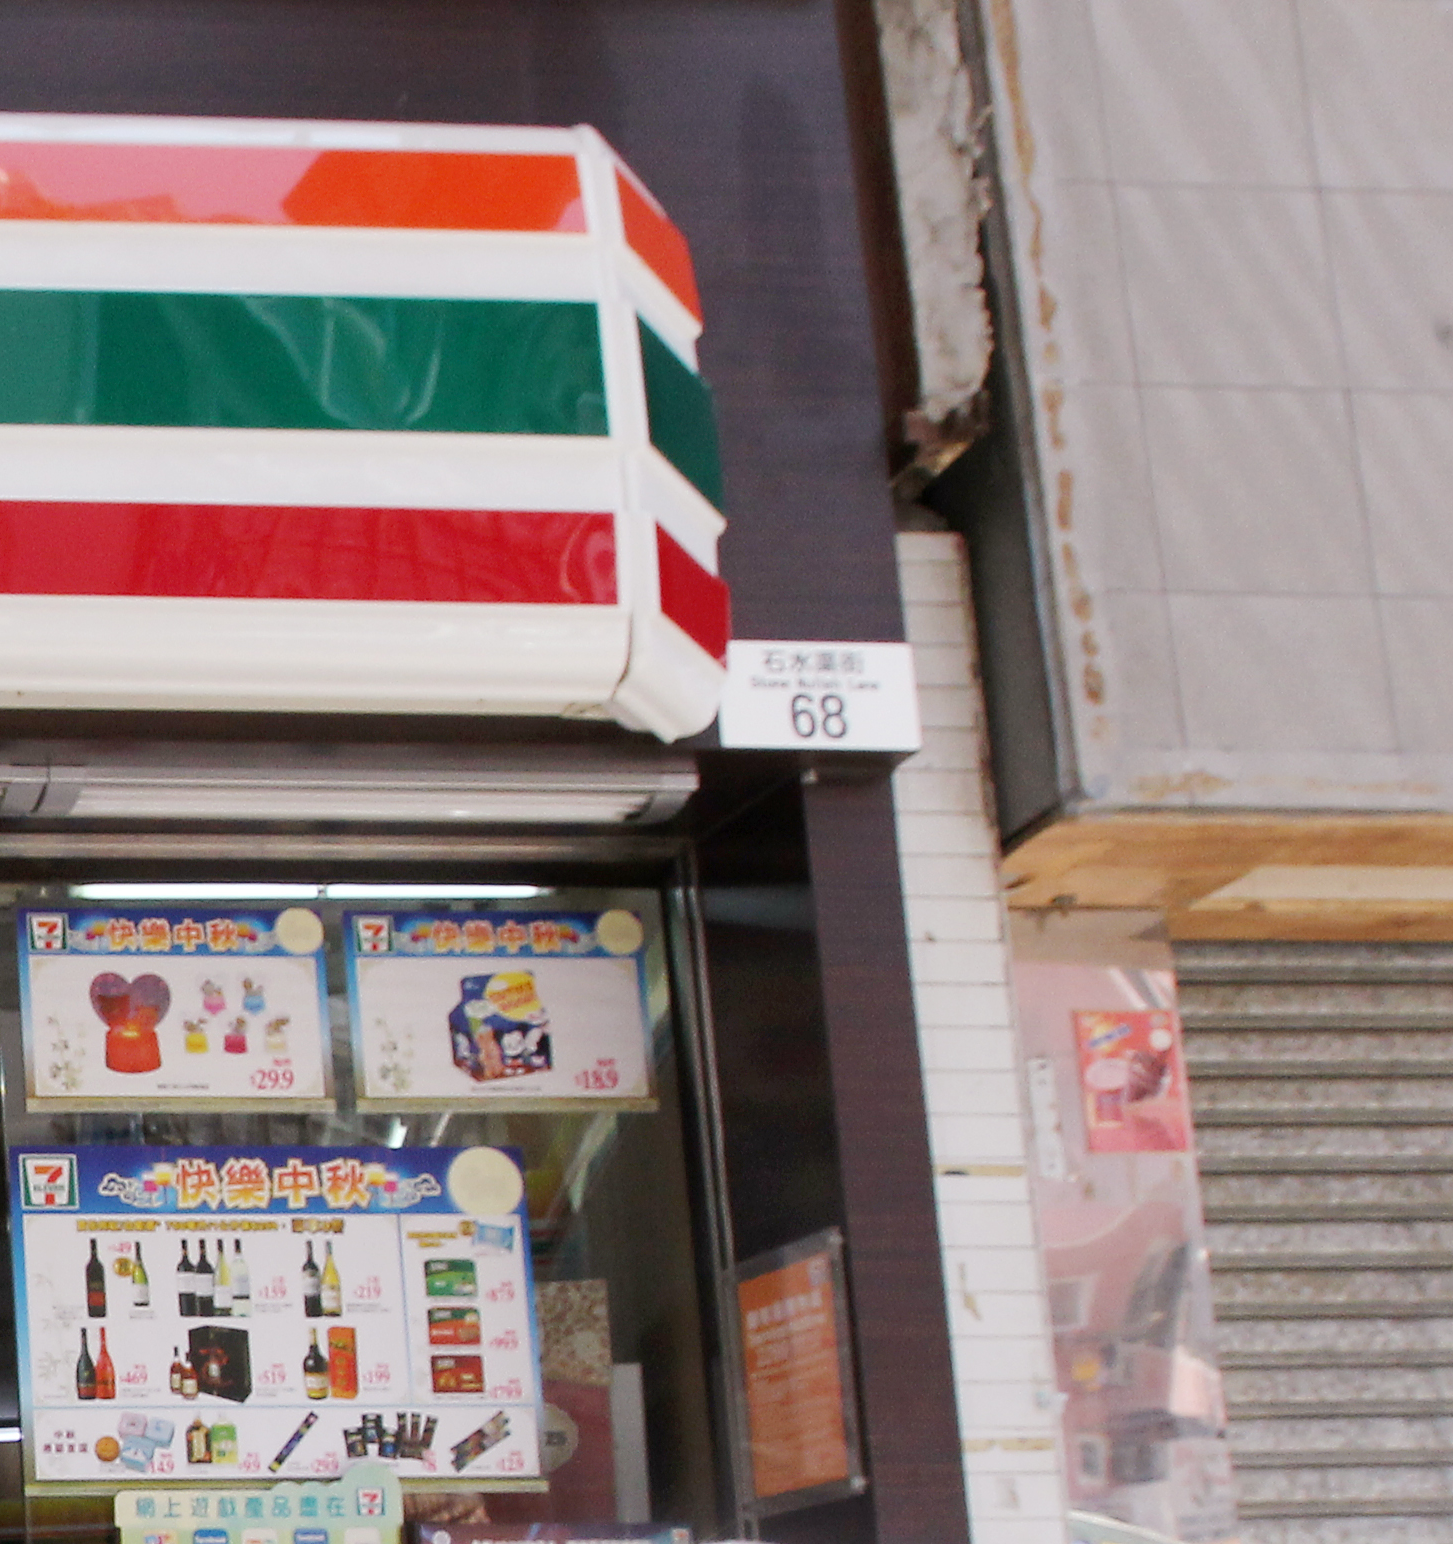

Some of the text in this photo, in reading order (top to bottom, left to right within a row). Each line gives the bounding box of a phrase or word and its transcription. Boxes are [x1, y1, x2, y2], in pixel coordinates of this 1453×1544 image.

[791, 694, 847, 739] 68
[175, 1159, 372, 1210] 快樂中秋
